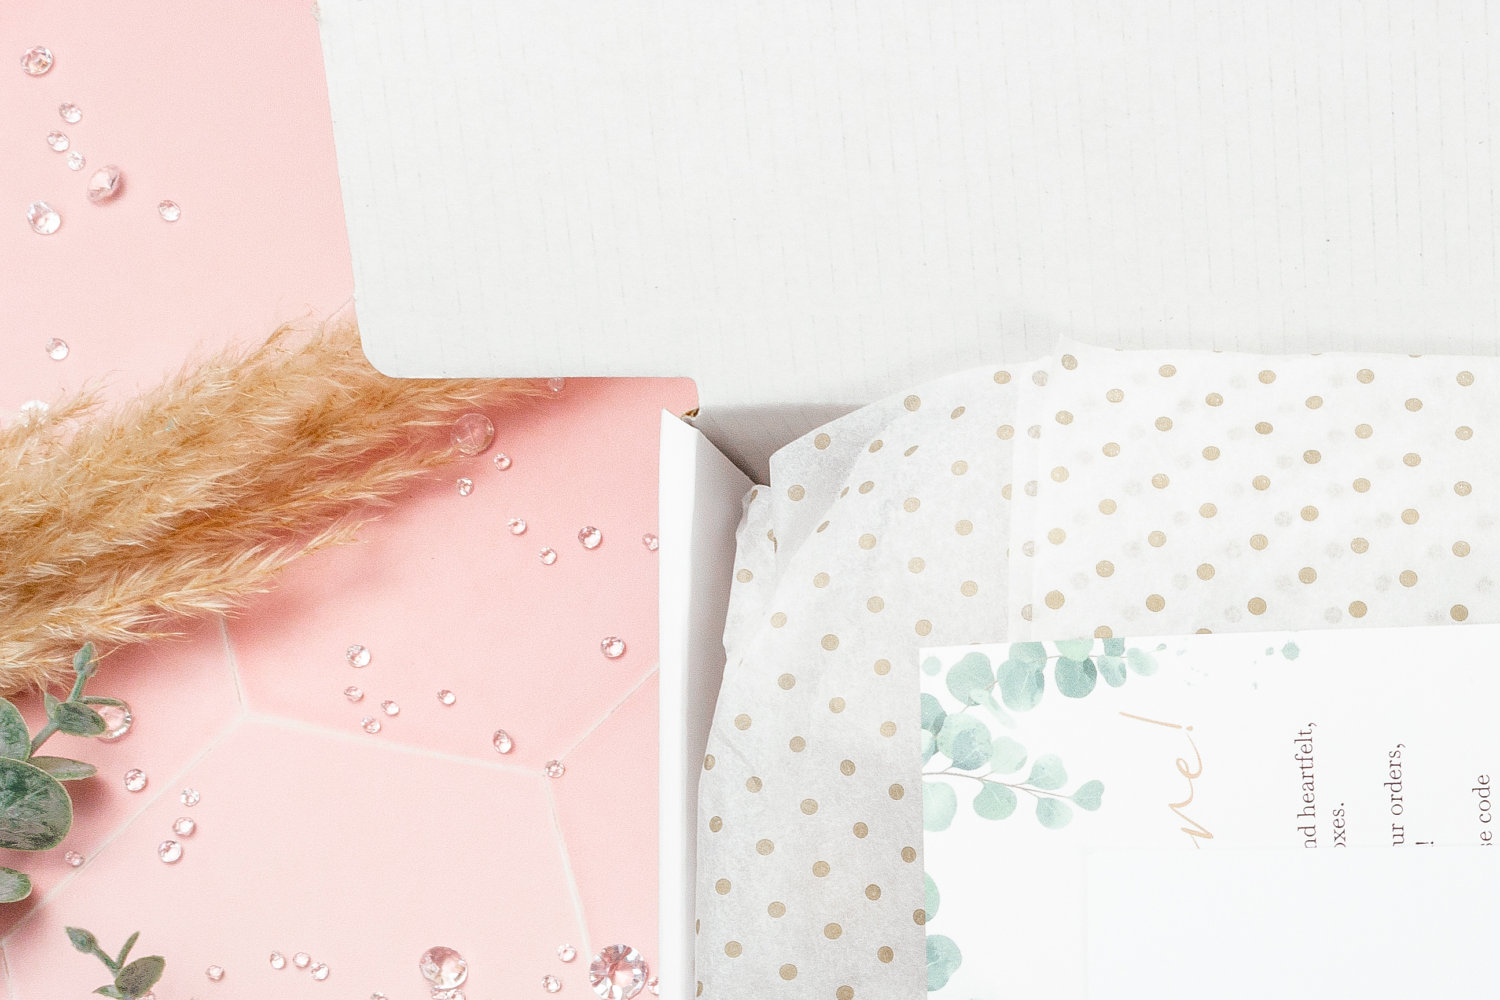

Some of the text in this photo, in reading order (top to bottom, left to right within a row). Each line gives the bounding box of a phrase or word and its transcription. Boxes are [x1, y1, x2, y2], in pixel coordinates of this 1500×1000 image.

[1294, 722, 1317, 818] heartfelt,
[1383, 743, 1406, 816] orders,
[1472, 774, 1491, 823] code
